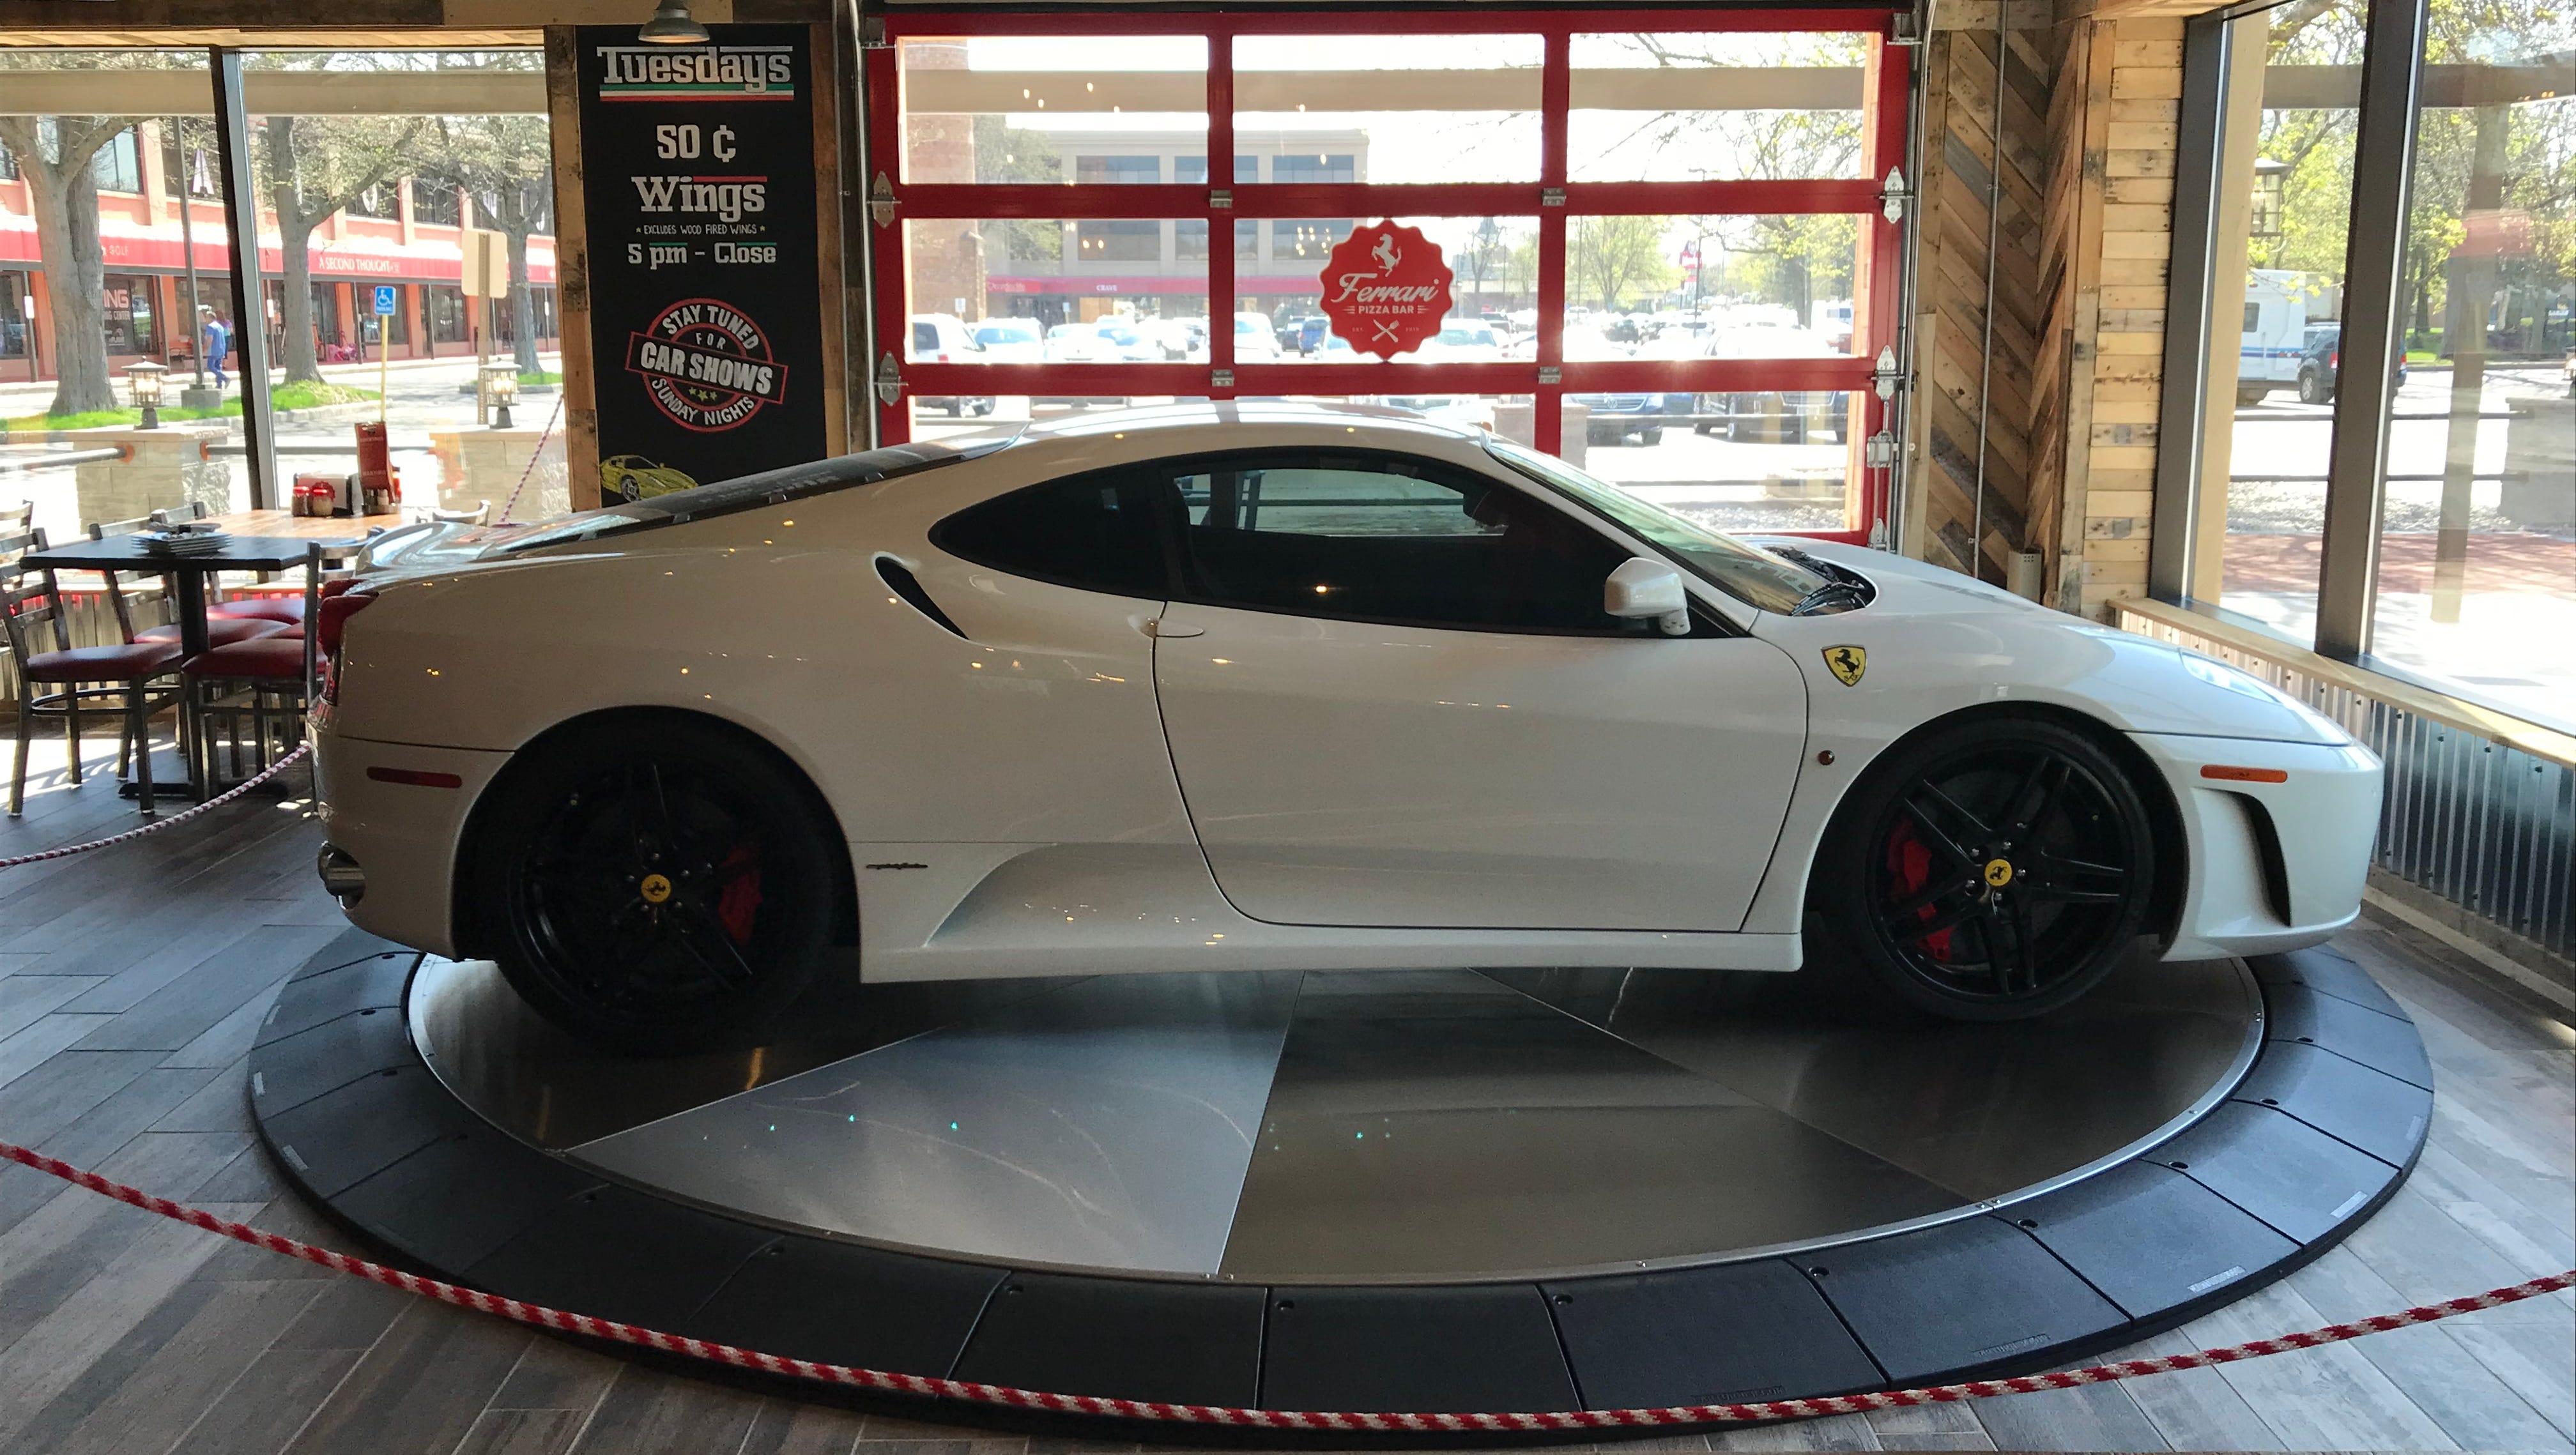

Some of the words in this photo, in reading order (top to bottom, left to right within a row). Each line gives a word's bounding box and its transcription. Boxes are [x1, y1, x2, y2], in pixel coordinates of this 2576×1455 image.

[597, 46, 793, 93] Tuesdays
[656, 125, 700, 159] 50
[631, 176, 766, 223] Wings
[643, 225, 677, 234] EXCLUDES
[680, 225, 702, 235] WOOD
[705, 224, 727, 234] FIRED
[730, 224, 757, 234] WINGS
[320, 257, 325, 269] A
[325, 257, 355, 271] SECOND
[356, 259, 390, 273] THOUGHT
[628, 243, 642, 264] 5
[649, 246, 687, 270] pm
[714, 242, 777, 263] Close
[1330, 273, 1439, 303] Ferrari
[1358, 305, 1390, 314] PIZZA
[1392, 305, 1414, 314] BAR
[662, 304, 701, 335] STAY
[707, 305, 759, 350] TUNED
[695, 332, 726, 350] FOR
[640, 341, 686, 376] CAR
[689, 353, 773, 394] SHOWS
[652, 378, 699, 423] SUNDAY
[704, 396, 755, 425] NIGHTS
